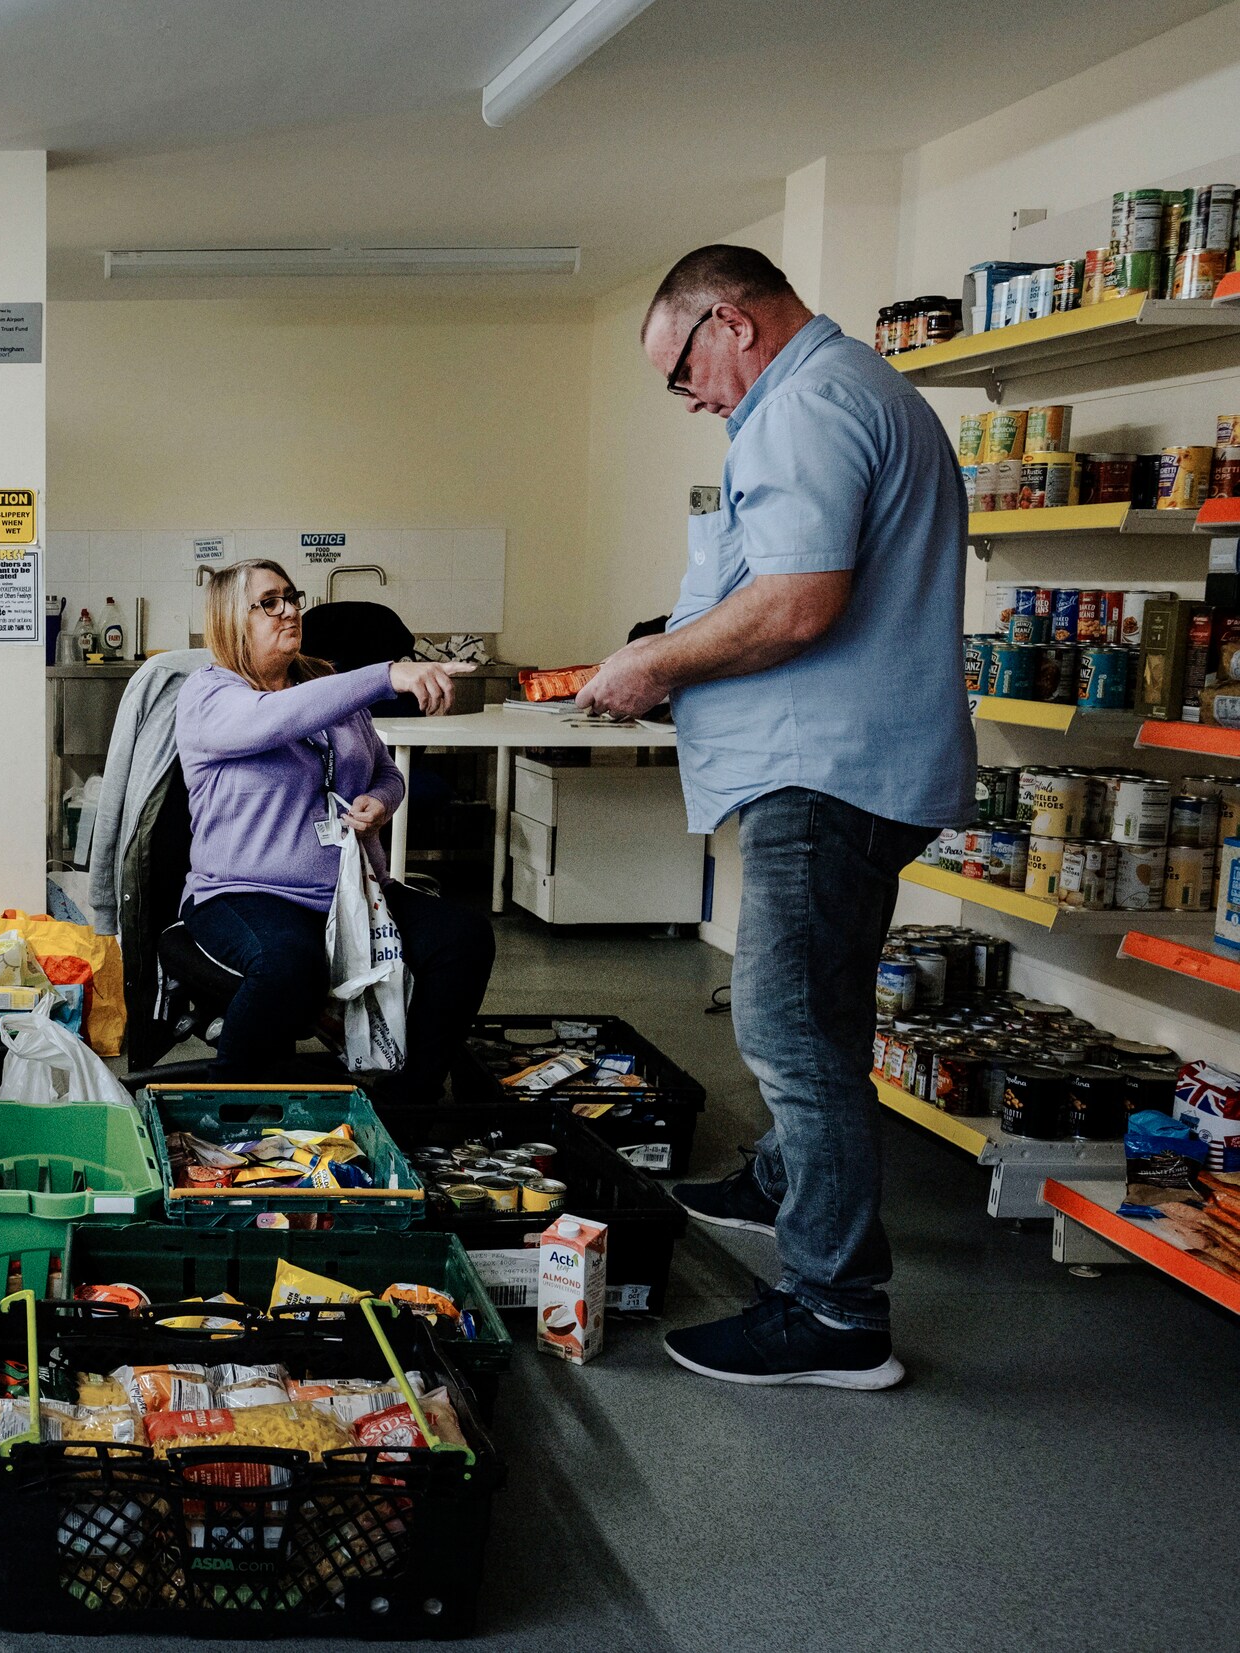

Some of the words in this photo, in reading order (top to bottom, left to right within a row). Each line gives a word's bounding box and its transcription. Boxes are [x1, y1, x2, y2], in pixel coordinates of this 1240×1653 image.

[302, 535, 344, 545] NOTICE
[965, 662, 981, 671] EANZ
[945, 846, 962, 855] Peas
[370, 922, 400, 940] astic
[542, 1272, 581, 1290] ALMOND
[189, 1556, 276, 1575] ASDA.com
